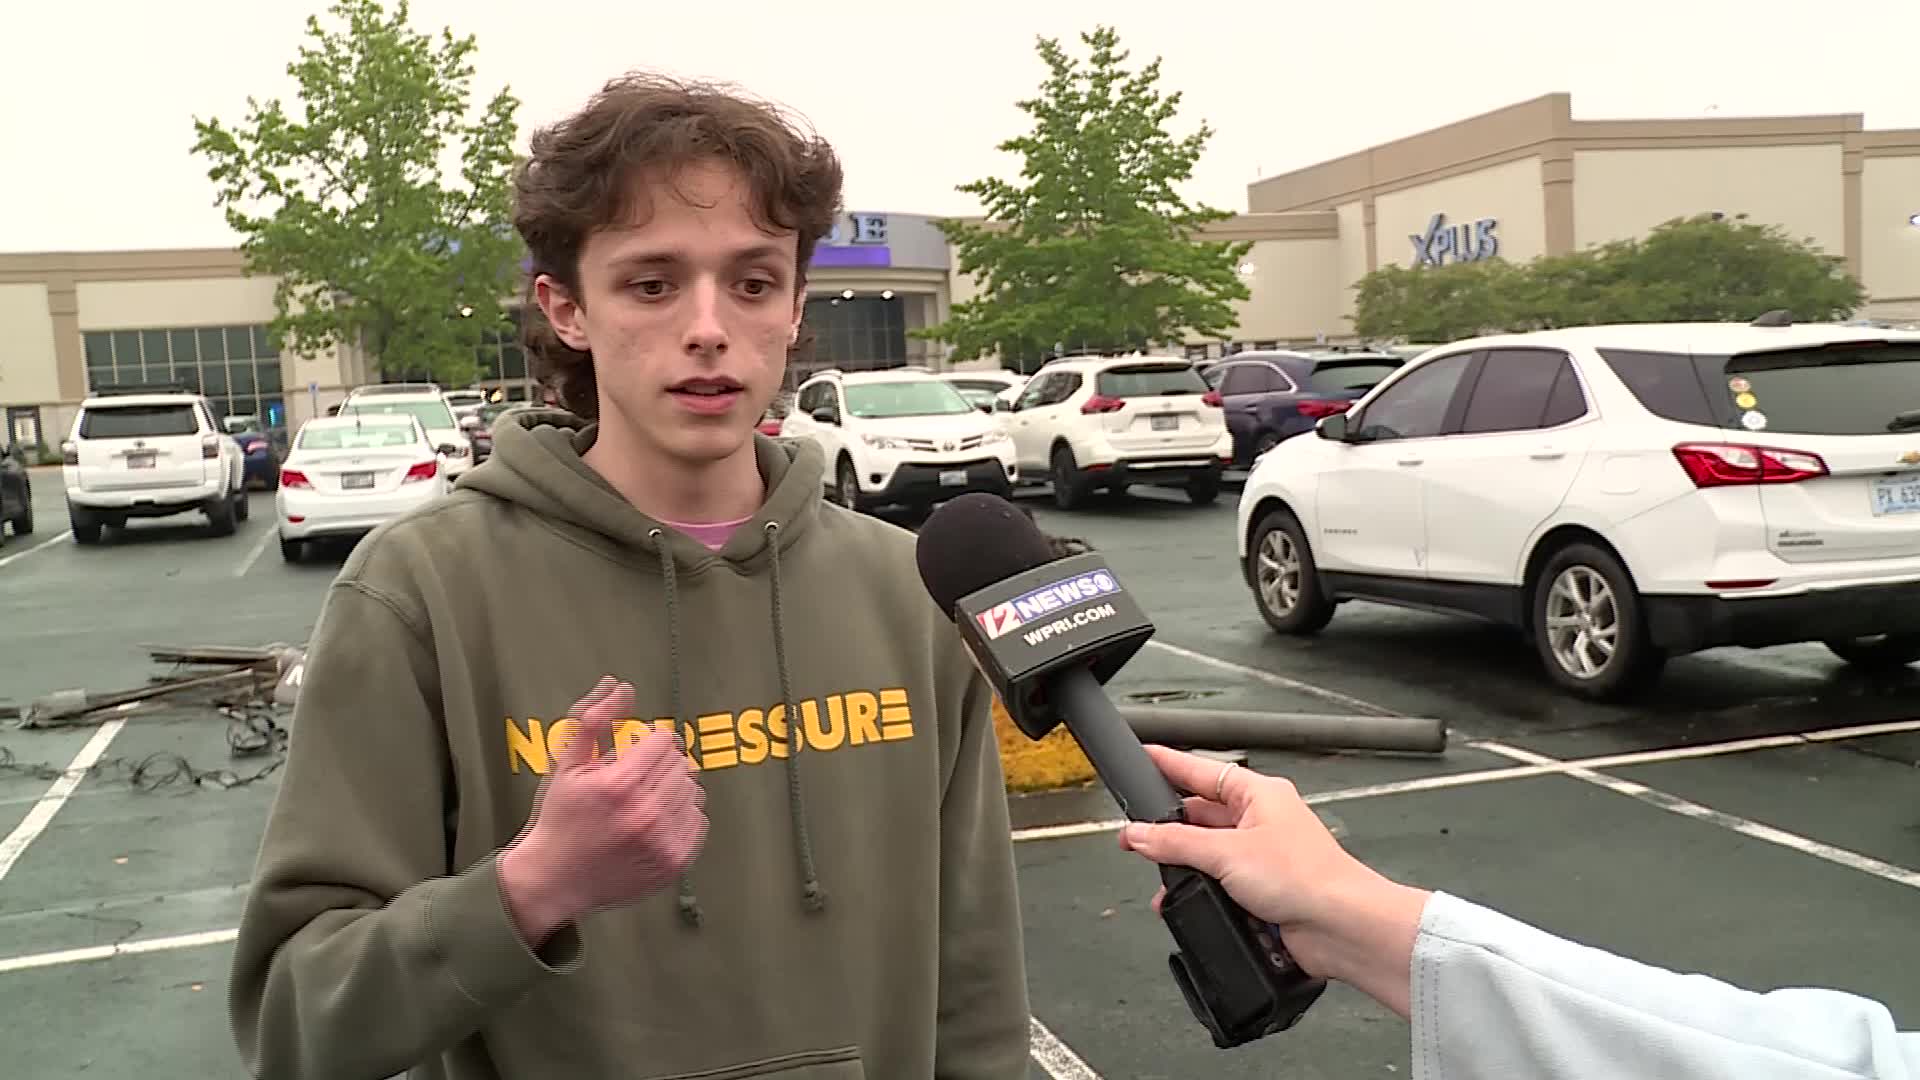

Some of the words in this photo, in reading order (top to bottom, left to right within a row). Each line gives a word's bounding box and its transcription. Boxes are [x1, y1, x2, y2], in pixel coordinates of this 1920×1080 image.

[1407, 213, 1497, 266] XPLUS
[979, 601, 1021, 640] 12
[1015, 577, 1098, 618] NEWS
[1023, 603, 1116, 646] WPRI.COM
